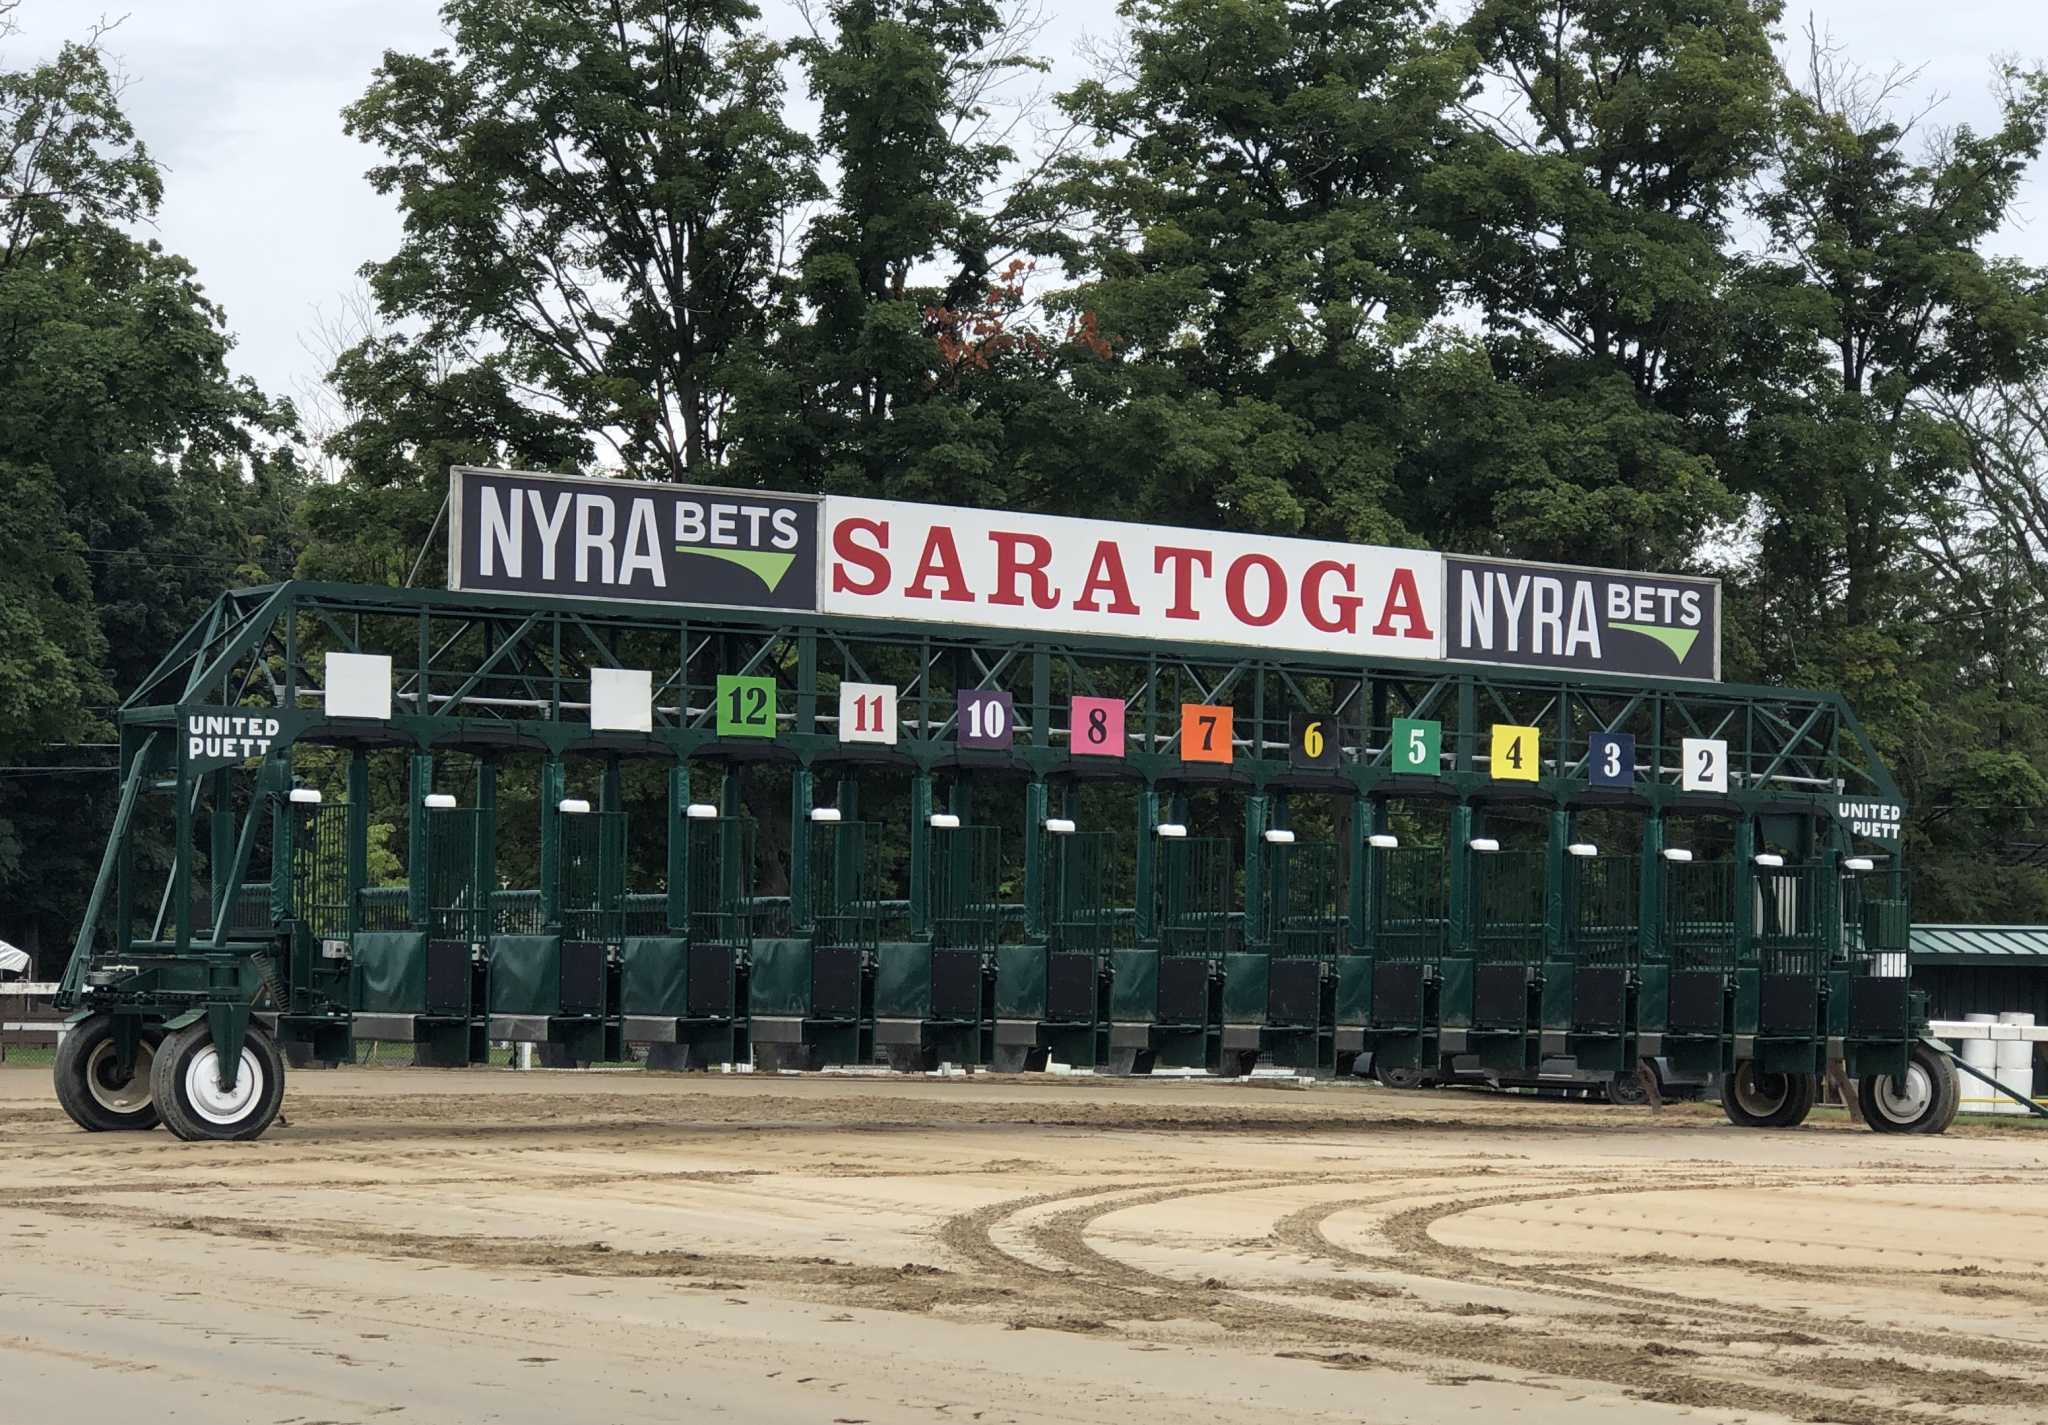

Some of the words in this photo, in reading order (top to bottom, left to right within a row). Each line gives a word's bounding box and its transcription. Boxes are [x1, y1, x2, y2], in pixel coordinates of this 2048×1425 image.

[480, 486, 667, 588] NYRA
[675, 501, 799, 550] BETS
[831, 517, 1434, 640] SARATOGA
[1461, 569, 1602, 658] NYRA
[1608, 583, 1701, 627] BETS
[728, 686, 768, 725] 12
[853, 694, 883, 732] 11
[968, 700, 1004, 739] 10
[189, 715, 280, 736] UNITED
[1088, 708, 1108, 745] 8
[1199, 716, 1217, 751] 7
[1304, 722, 1324, 759] 6
[189, 737, 272, 760] PUETT
[1408, 729, 1426, 764] 5
[1505, 735, 1523, 770] 4
[1604, 743, 1621, 778] 3
[1698, 749, 1715, 783] 2
[1839, 802, 1901, 821] UNITED
[1853, 821, 1901, 840] PUETT
